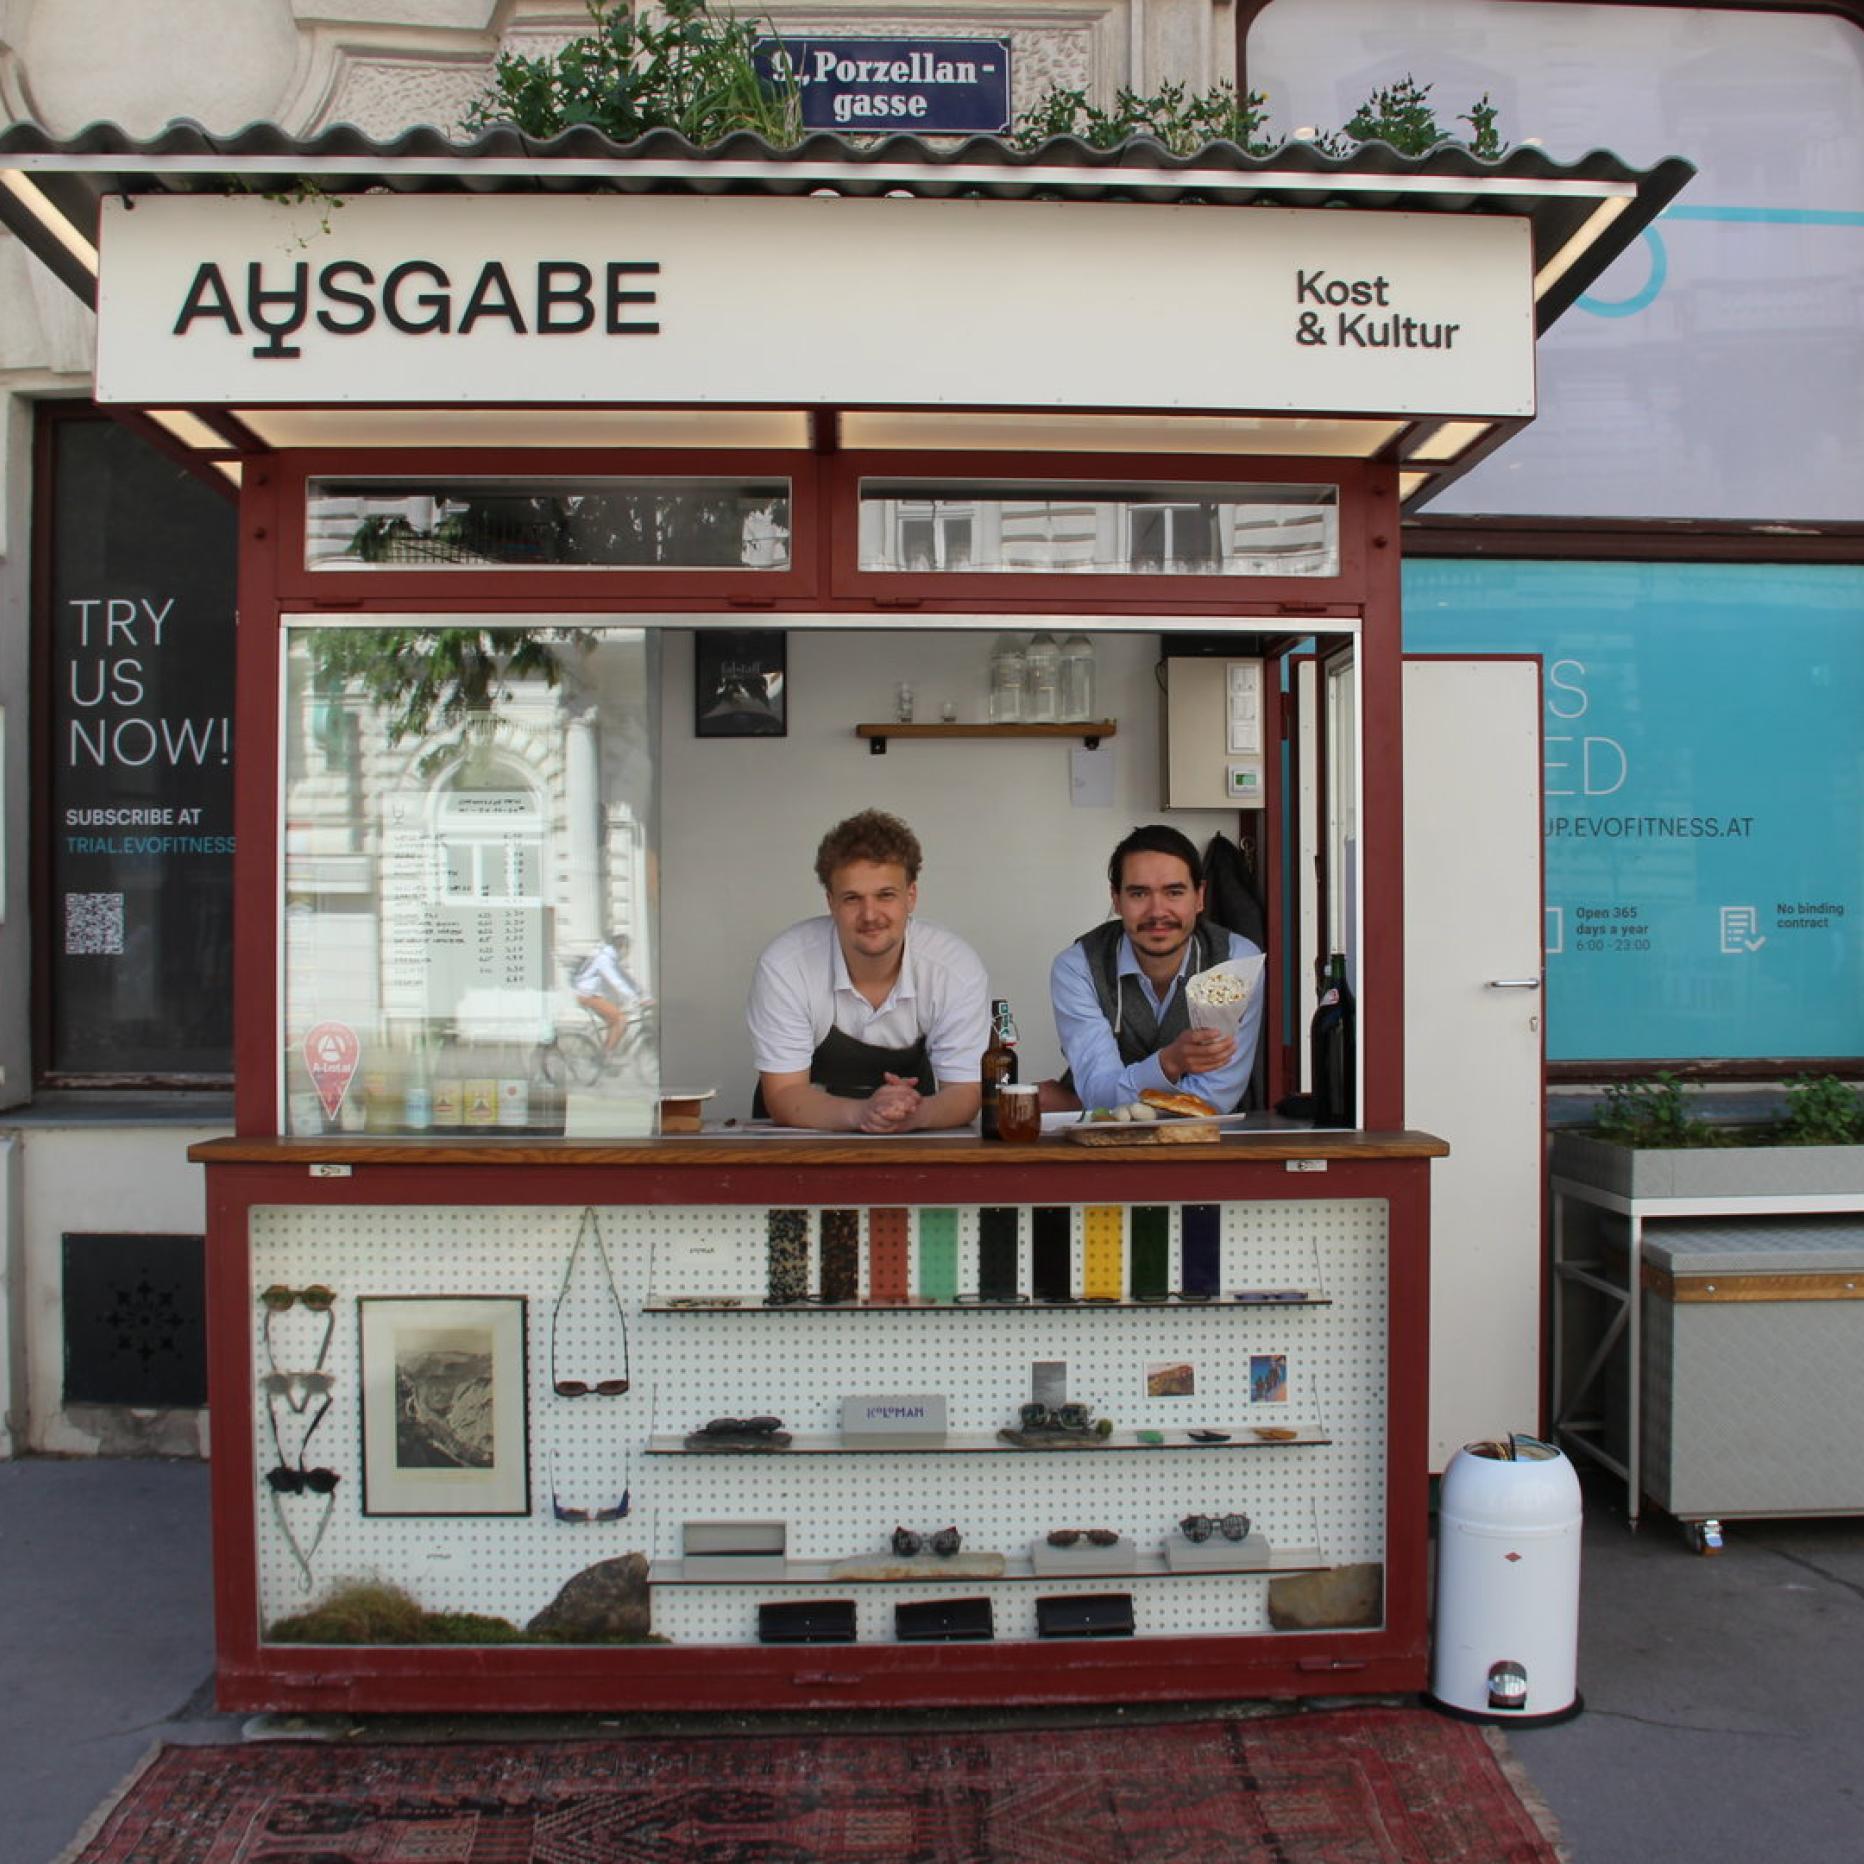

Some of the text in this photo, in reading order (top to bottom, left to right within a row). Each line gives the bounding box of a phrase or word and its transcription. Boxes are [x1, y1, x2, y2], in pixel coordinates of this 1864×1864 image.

[833, 94, 928, 121] gasse
[1297, 269, 1389, 306] Kost
[172, 260, 660, 359] AUSGABE
[1296, 311, 1460, 349] & Kultur
[69, 599, 174, 646] TRY
[71, 659, 144, 706] US
[70, 717, 230, 766] NOW!
[66, 809, 203, 826] SUBSCRIBE AT
[66, 836, 237, 854] TRIAL.EVOFITNESS
[1576, 906, 1637, 921] Open 365
[1777, 902, 1844, 917] No binding
[1777, 917, 1829, 928] contract
[1576, 923, 1606, 937] days
[1621, 926, 1648, 937] year
